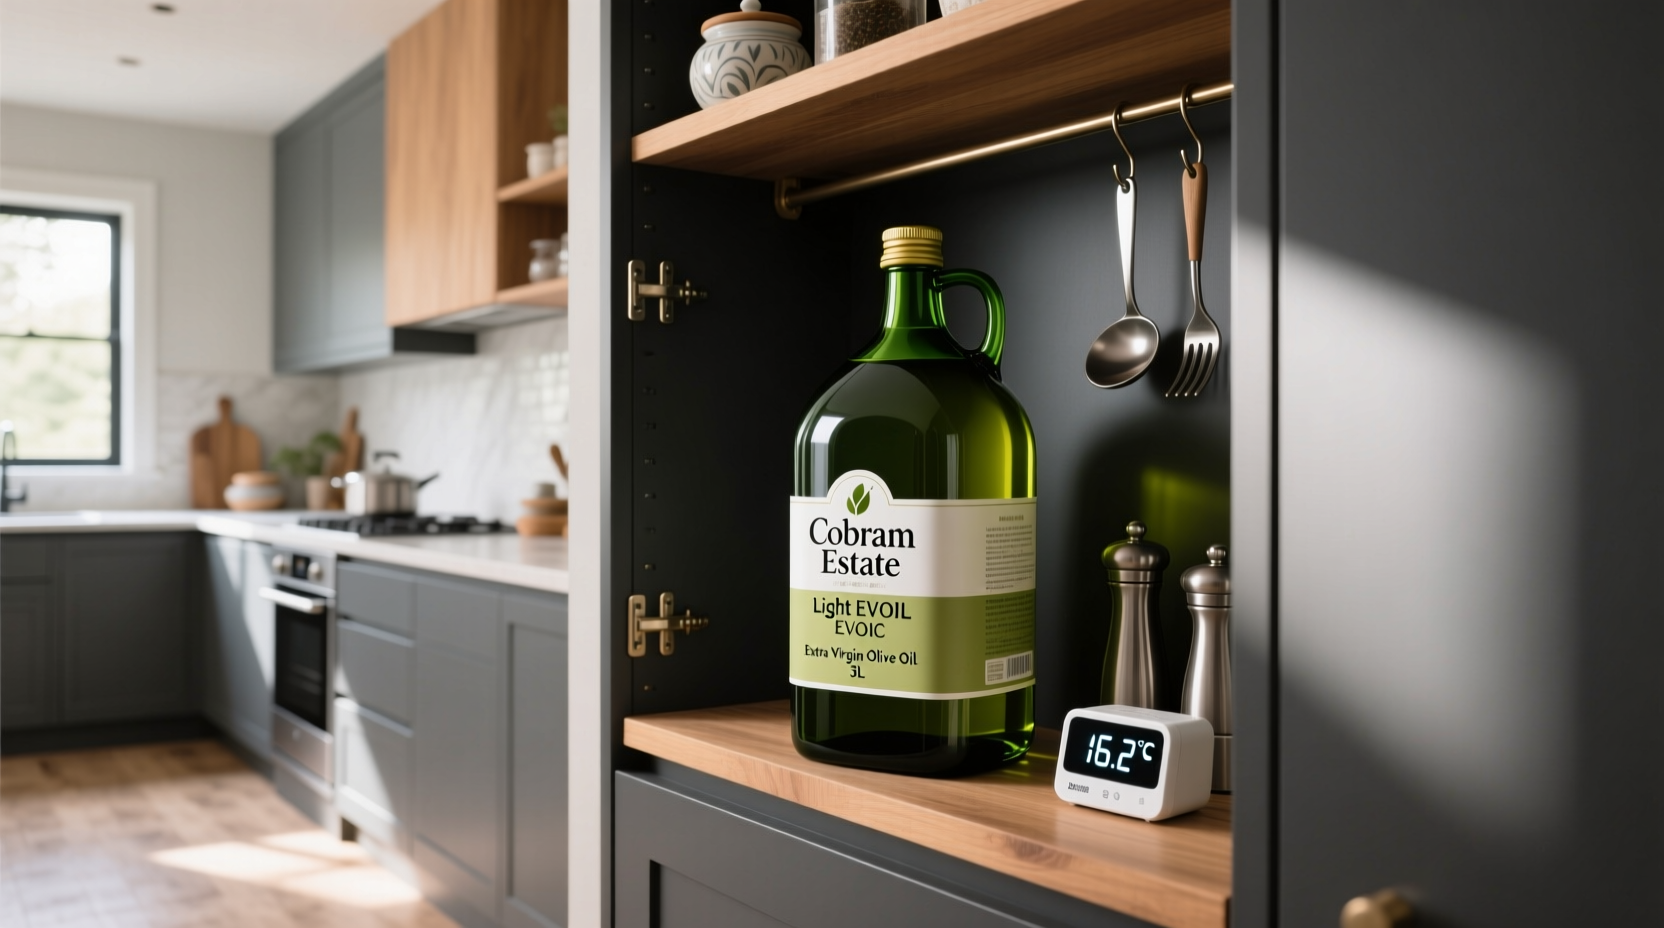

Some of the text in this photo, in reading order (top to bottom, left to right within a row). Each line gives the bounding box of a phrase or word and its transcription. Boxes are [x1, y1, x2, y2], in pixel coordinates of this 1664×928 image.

[809, 517, 916, 549] Cobram
[820, 549, 901, 577] Estate
[813, 597, 912, 620] Light EVOIL
[835, 620, 886, 639] EVOIC
[804, 644, 918, 666] Extra Virgin Olive Oil
[850, 665, 866, 679] 3L
